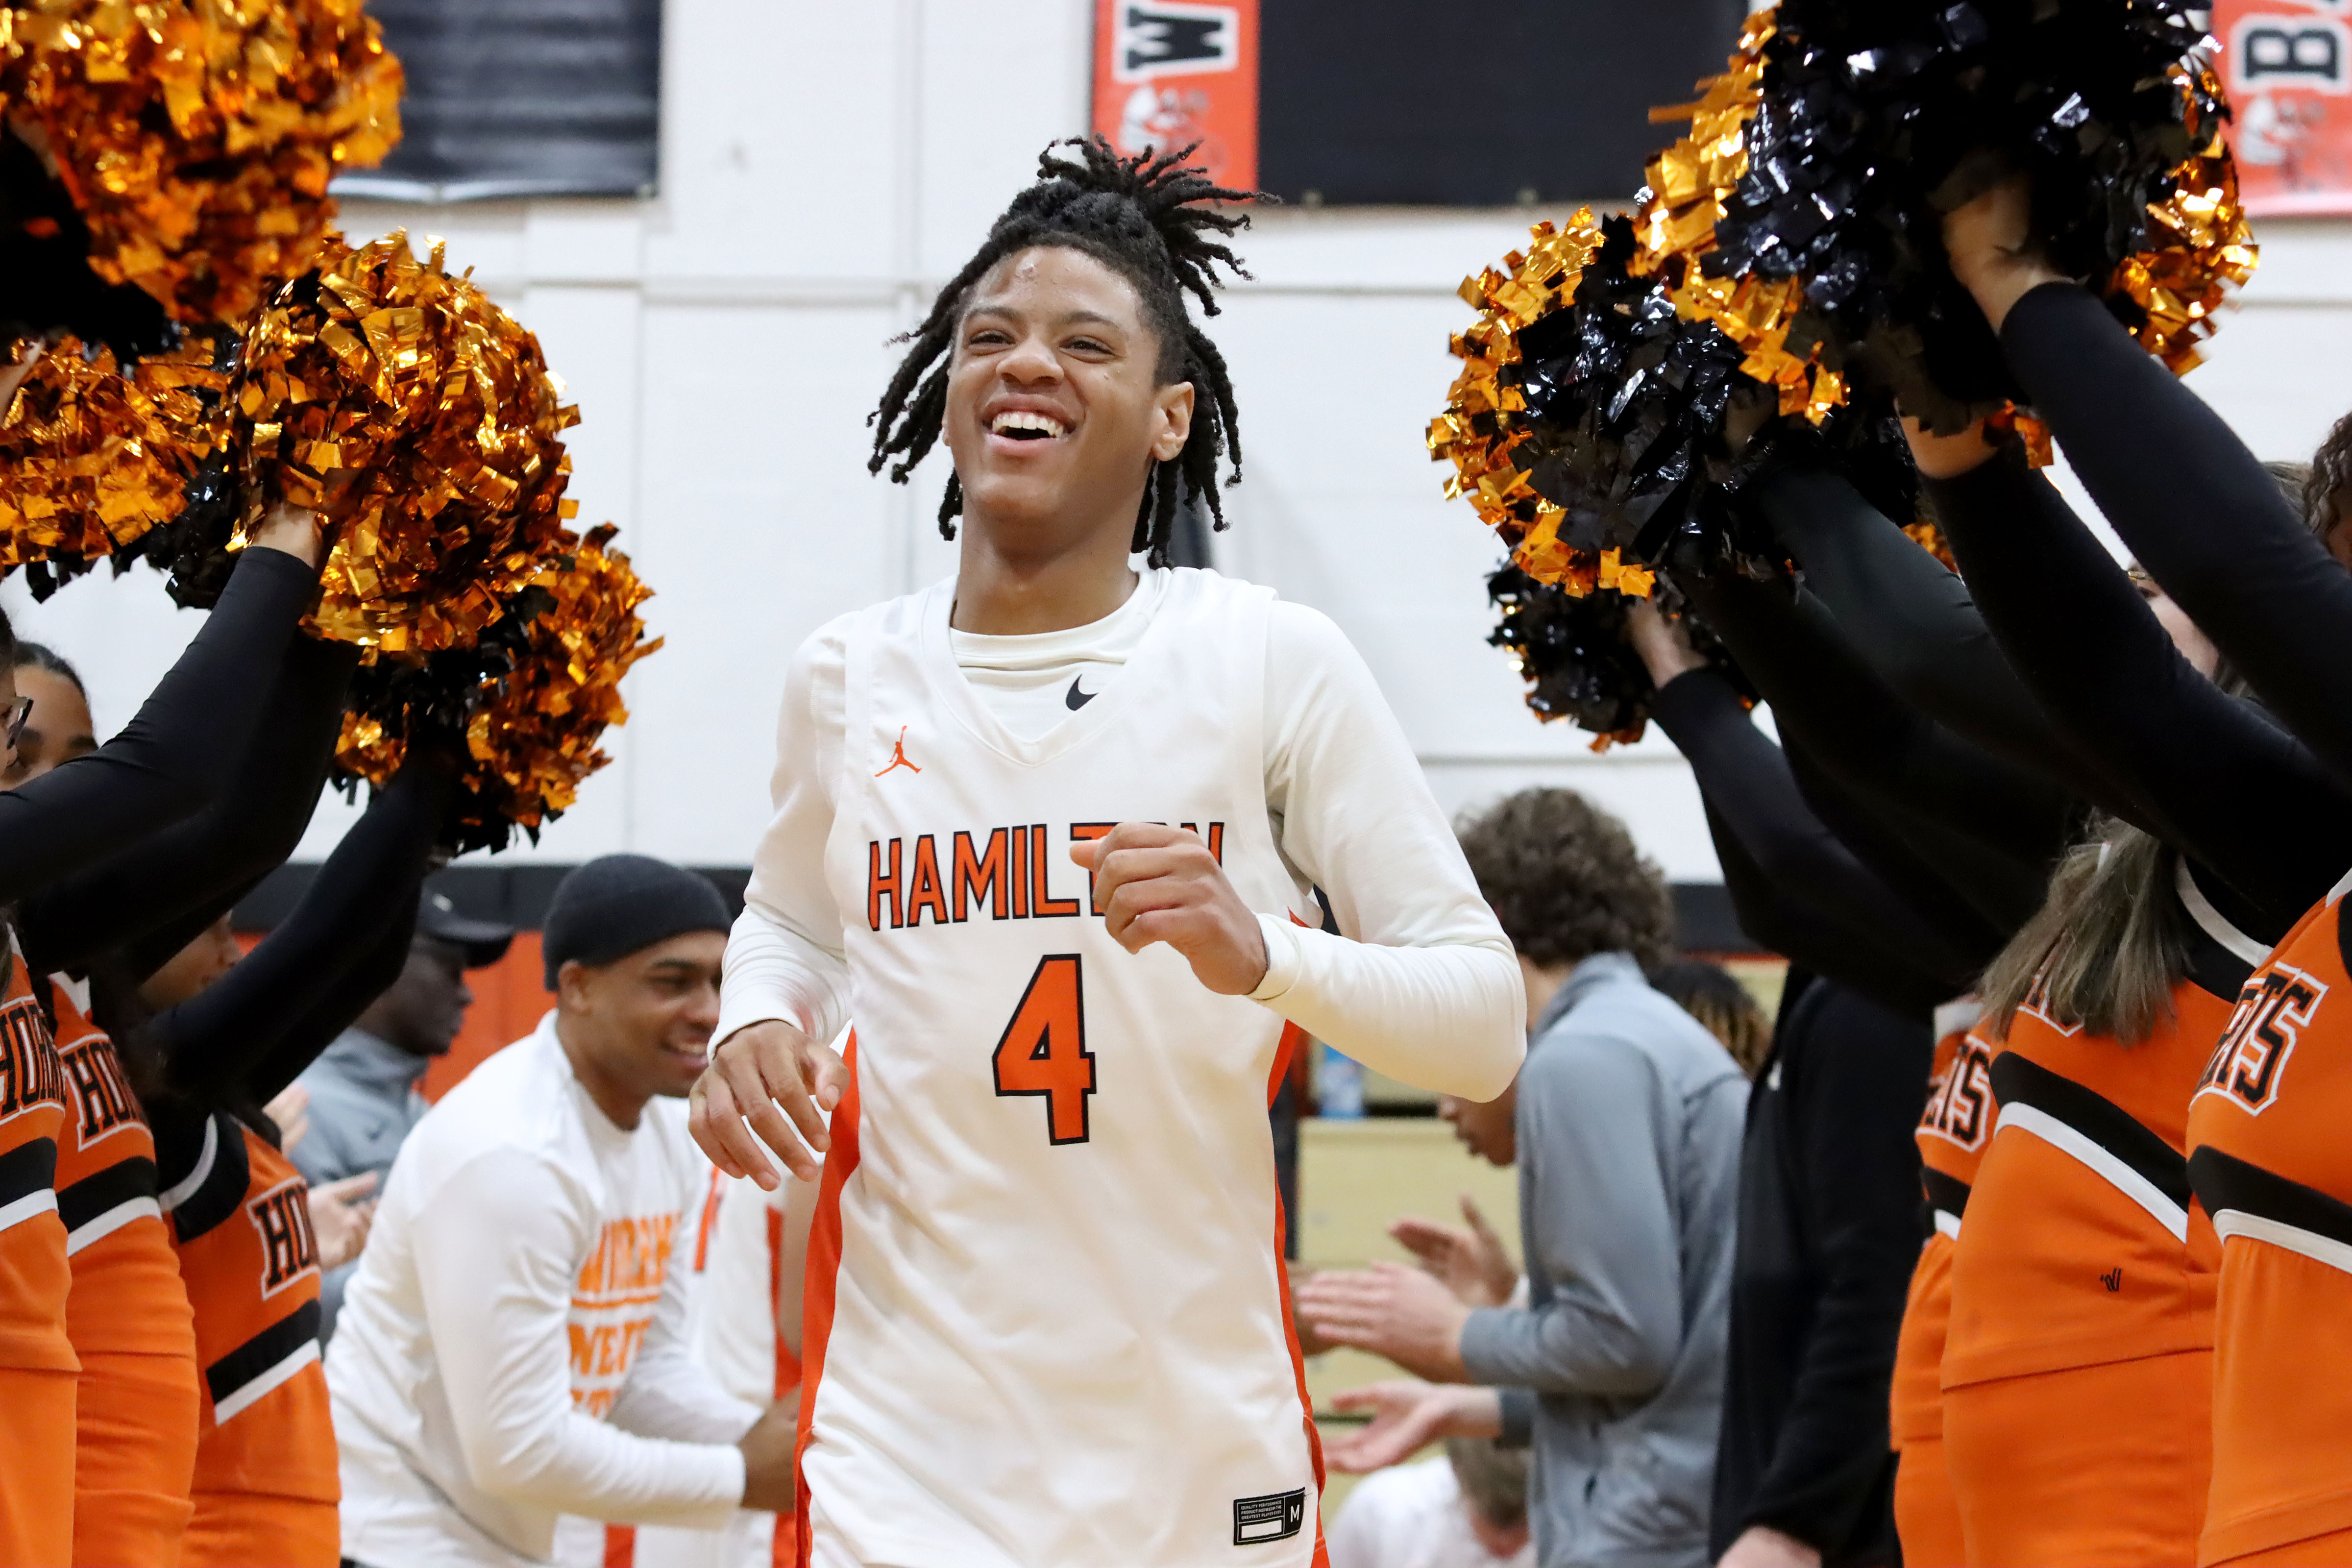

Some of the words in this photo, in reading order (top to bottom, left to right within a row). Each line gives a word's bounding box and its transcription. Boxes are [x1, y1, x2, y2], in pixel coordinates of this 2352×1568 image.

[2241, 0, 2341, 83] B
[868, 822, 1225, 932] HAMILT
[992, 953, 1097, 1146] 4
[1290, 1504, 1300, 1523] M
